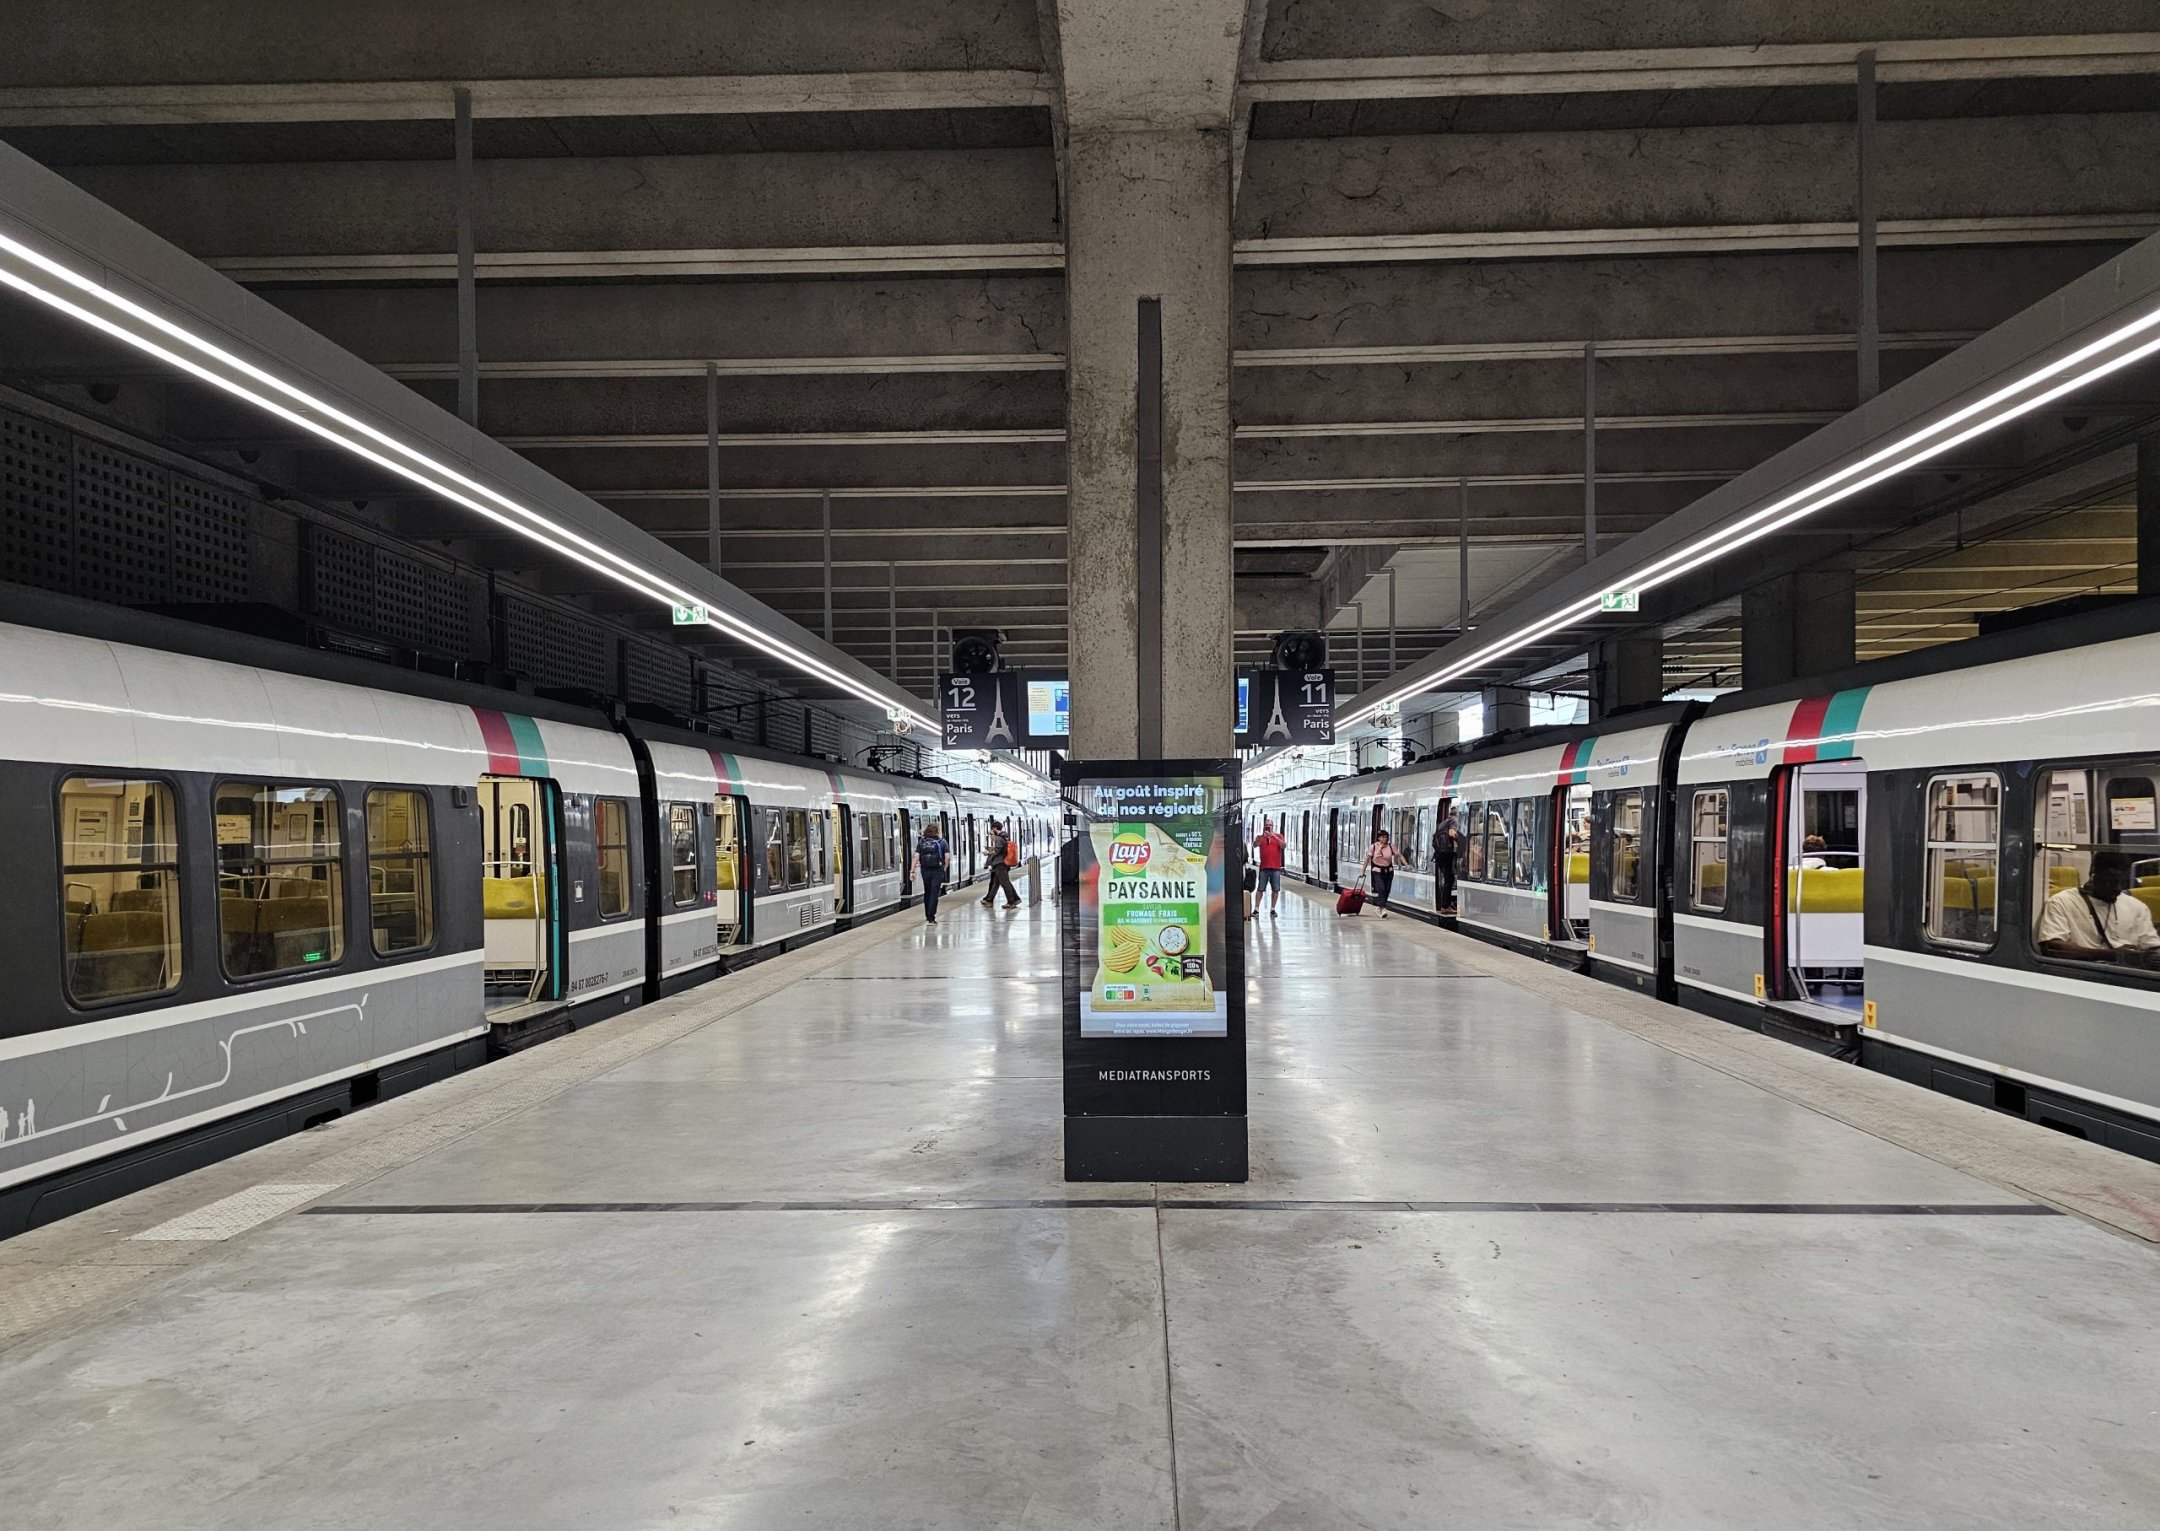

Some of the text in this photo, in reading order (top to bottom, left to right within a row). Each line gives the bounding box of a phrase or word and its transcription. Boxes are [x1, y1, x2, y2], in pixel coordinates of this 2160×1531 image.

[948, 687, 976, 708] 12
[1301, 683, 1327, 703] 11
[946, 723, 973, 733] Paris
[1303, 719, 1330, 729] Paris
[1094, 784, 1205, 801] Au goût inspiré
[1098, 803, 1205, 818] de nos régions
[1111, 843, 1150, 864] Lay's
[1108, 881, 1196, 899] PAYSANNE
[1126, 910, 1178, 918] FROMAGE FRAIS
[1098, 1070, 1211, 1081] MEDIATRANSPORTS
